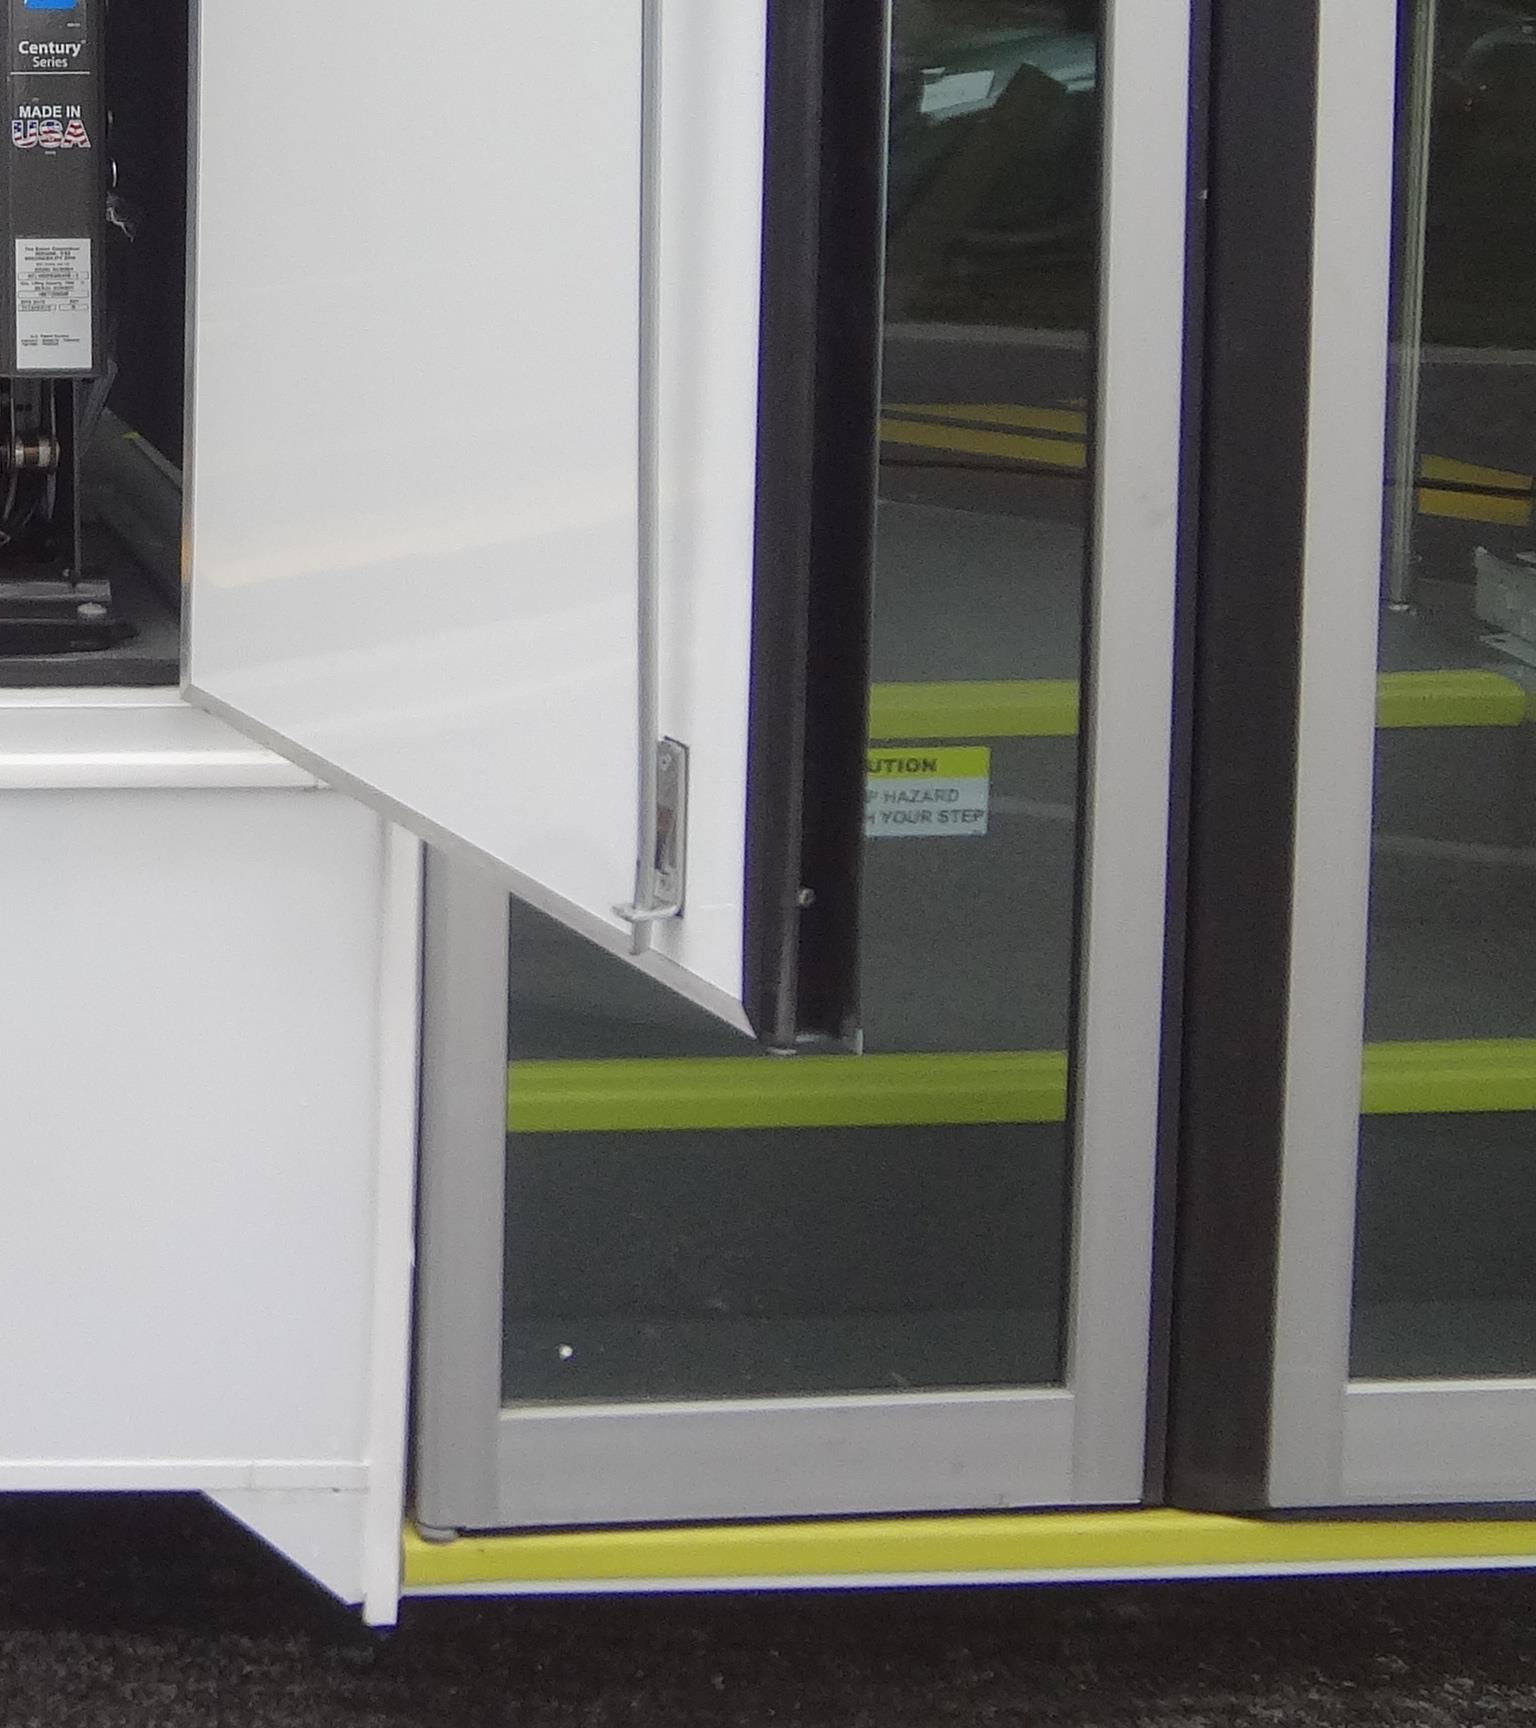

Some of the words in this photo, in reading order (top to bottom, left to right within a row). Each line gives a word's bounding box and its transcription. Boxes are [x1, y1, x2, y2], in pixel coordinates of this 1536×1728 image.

[18, 40, 82, 57] Century
[32, 56, 68, 67] Series
[19, 105, 62, 117] MADE
[66, 105, 81, 117] IN
[11, 119, 92, 148] USA
[868, 758, 938, 773] UTION
[883, 788, 959, 804] HAZARD
[881, 810, 932, 824] YOUR
[937, 809, 985, 824] STEP
